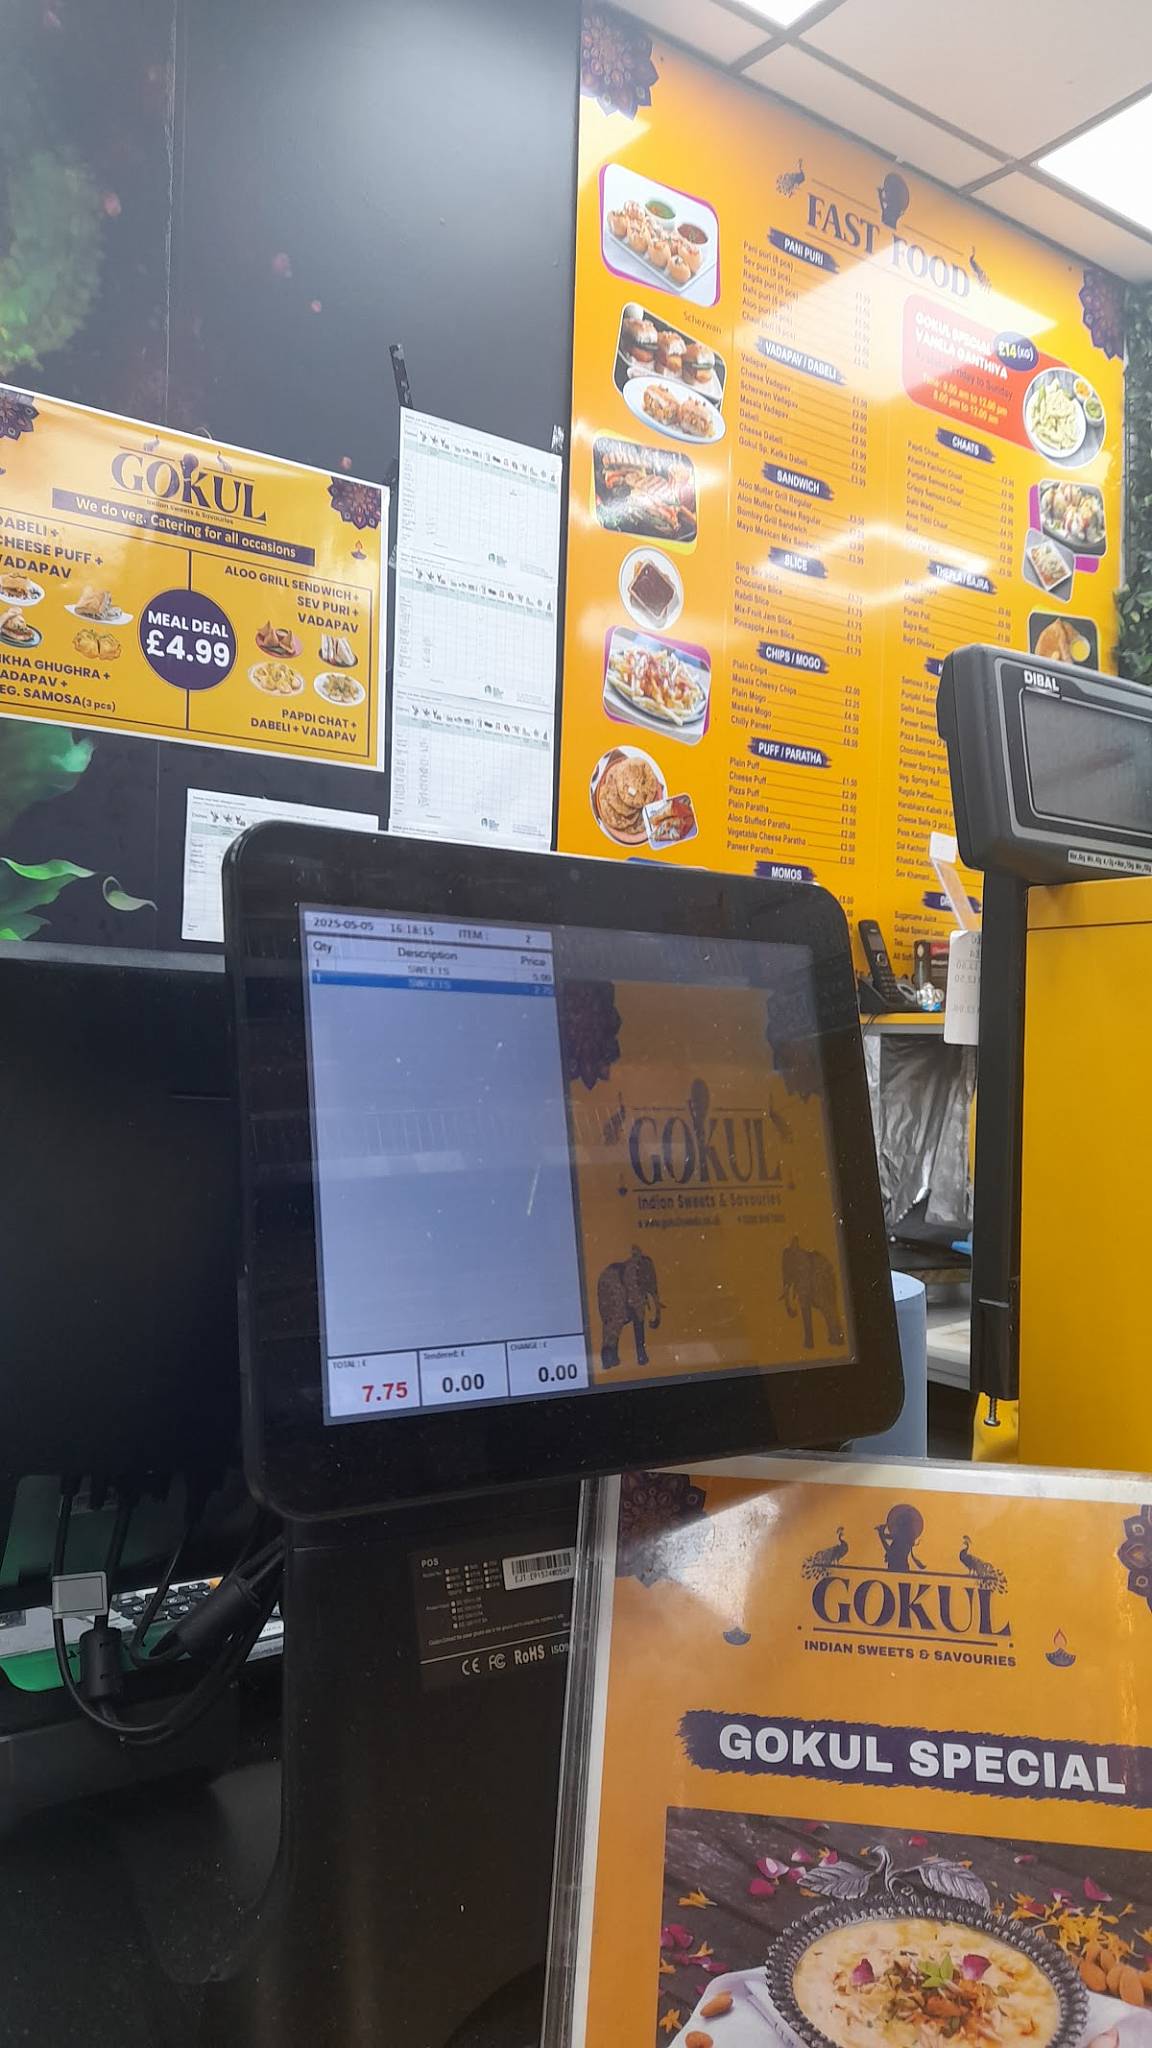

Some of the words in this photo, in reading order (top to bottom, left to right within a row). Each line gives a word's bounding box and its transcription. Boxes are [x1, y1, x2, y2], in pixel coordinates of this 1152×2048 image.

[784, 238, 803, 257] PANI
[804, 246, 824, 265] PURI
[808, 193, 881, 254] FAST
[891, 232, 970, 298] FOOD
[765, 341, 802, 367] VADAPAV
[808, 358, 837, 379] DABELI
[952, 436, 979, 456] CHAATS
[111, 452, 267, 522] GOKUL
[777, 470, 820, 495] SANDWICH
[51, 528, 59, 537] +
[76, 496, 98, 512] We
[101, 502, 117, 518] do
[121, 508, 146, 524] veg.
[151, 514, 201, 538] Catering
[204, 527, 222, 542] for
[225, 532, 239, 545] all
[242, 537, 296, 559] occasions
[0, 554, 71, 579] ADAPAV
[55, 546, 91, 564] PUFF
[95, 556, 103, 566] +
[784, 554, 808, 571] SLICE
[224, 565, 256, 580] ALOO
[260, 572, 289, 588] GRILL
[292, 579, 351, 600] SENDWICH
[297, 595, 320, 609] SEV
[323, 601, 350, 616] PURI
[352, 608, 359, 616] +
[148, 610, 190, 633] MEAL
[192, 619, 229, 639] DEAL
[298, 612, 358, 634] VADAPAV
[146, 629, 231, 668] £4.99
[766, 646, 790, 663] CHIPS
[796, 653, 820, 670] MOGO
[34, 660, 100, 679] GHUGHRA
[103, 672, 110, 680] +
[1024, 670, 1060, 692] DIBAL
[60, 680, 67, 688] +
[94, 701, 116, 712] pcs)
[282, 709, 316, 723] PAPDI
[319, 715, 348, 728] CHAT
[251, 718, 291, 733] DABELI
[302, 725, 357, 742] VADAPAV
[758, 742, 779, 757] PUFF
[785, 748, 822, 765] PARATHA
[771, 866, 802, 880] MOMOS
[313, 918, 375, 931] 2025-05-05
[458, 930, 483, 940] ITEM
[526, 935, 531, 943] 2
[313, 940, 332, 954] Qty
[398, 947, 458, 961] Description
[520, 956, 546, 967] Price
[408, 965, 450, 976] SWEETS
[629, 1116, 782, 1185] GOKUL
[637, 1194, 674, 1211] Indian
[678, 1194, 716, 1209] Sweets
[719, 1194, 727, 1207] &
[731, 1193, 782, 1207] Savouries
[510, 1342, 538, 1351] CHANGE
[332, 1359, 355, 1370] TOTAL
[538, 1364, 578, 1383] 0.00
[362, 1381, 408, 1403] 7.75
[442, 1373, 485, 1394] 0.00
[421, 1558, 439, 1568] POS
[811, 1575, 1011, 1637] GOKUL
[514, 1644, 545, 1665] RoHS
[804, 1640, 853, 1654] INDIAN
[857, 1644, 915, 1660] SWEETS
[919, 1650, 931, 1660] &
[934, 1650, 1016, 1667] SAVOURIES
[719, 1723, 893, 1774] GOKUL
[909, 1740, 1126, 1795] SPECIAL
